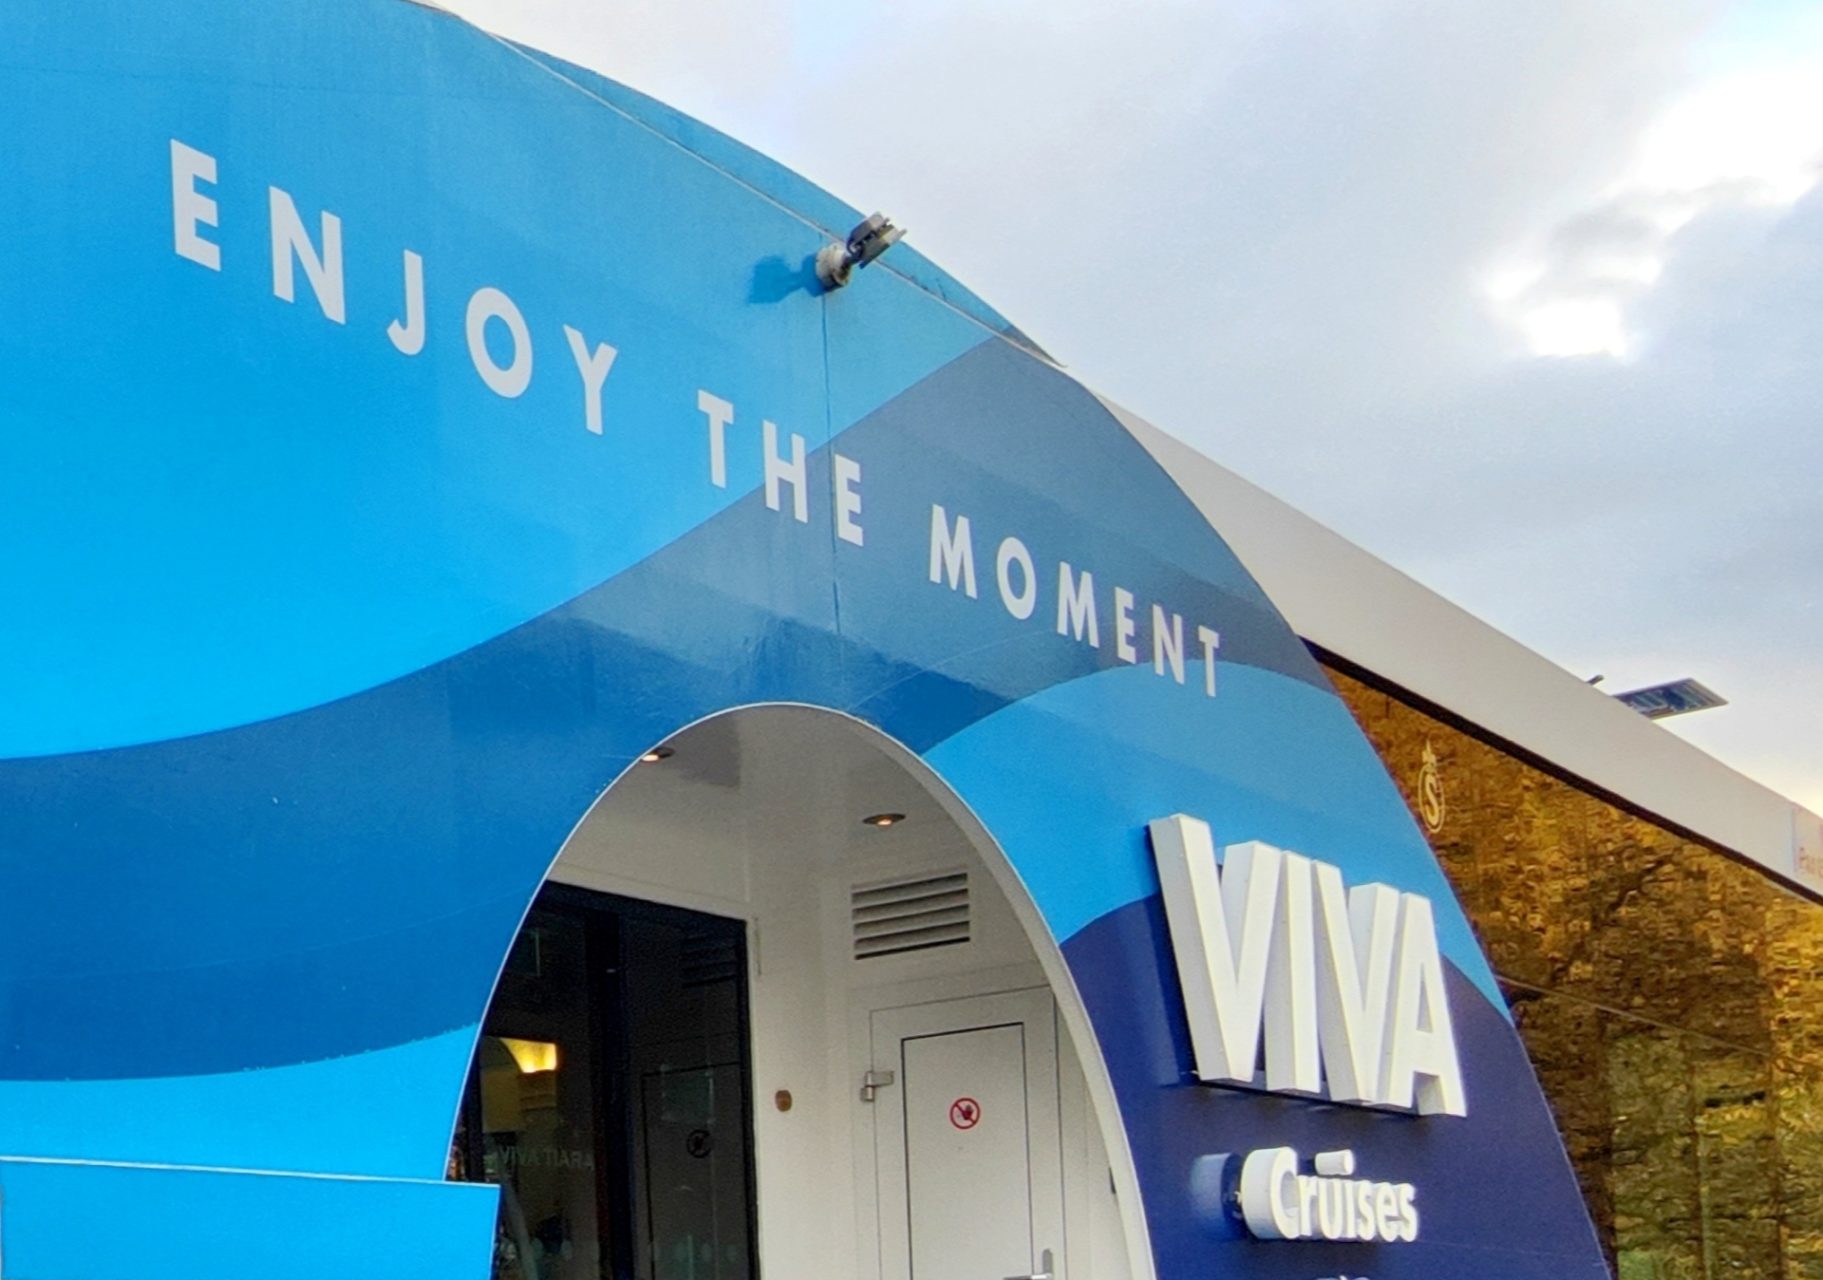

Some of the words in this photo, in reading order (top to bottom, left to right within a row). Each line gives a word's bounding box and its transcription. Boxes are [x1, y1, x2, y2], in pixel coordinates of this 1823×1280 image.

[171, 139, 618, 435] ENJOY
[698, 390, 863, 546] THE
[928, 504, 1220, 698] MOMENT
[1150, 813, 1468, 1118] VIVA
[498, 1146, 542, 1168] VIVA
[1240, 1146, 1419, 1242] Cruises
